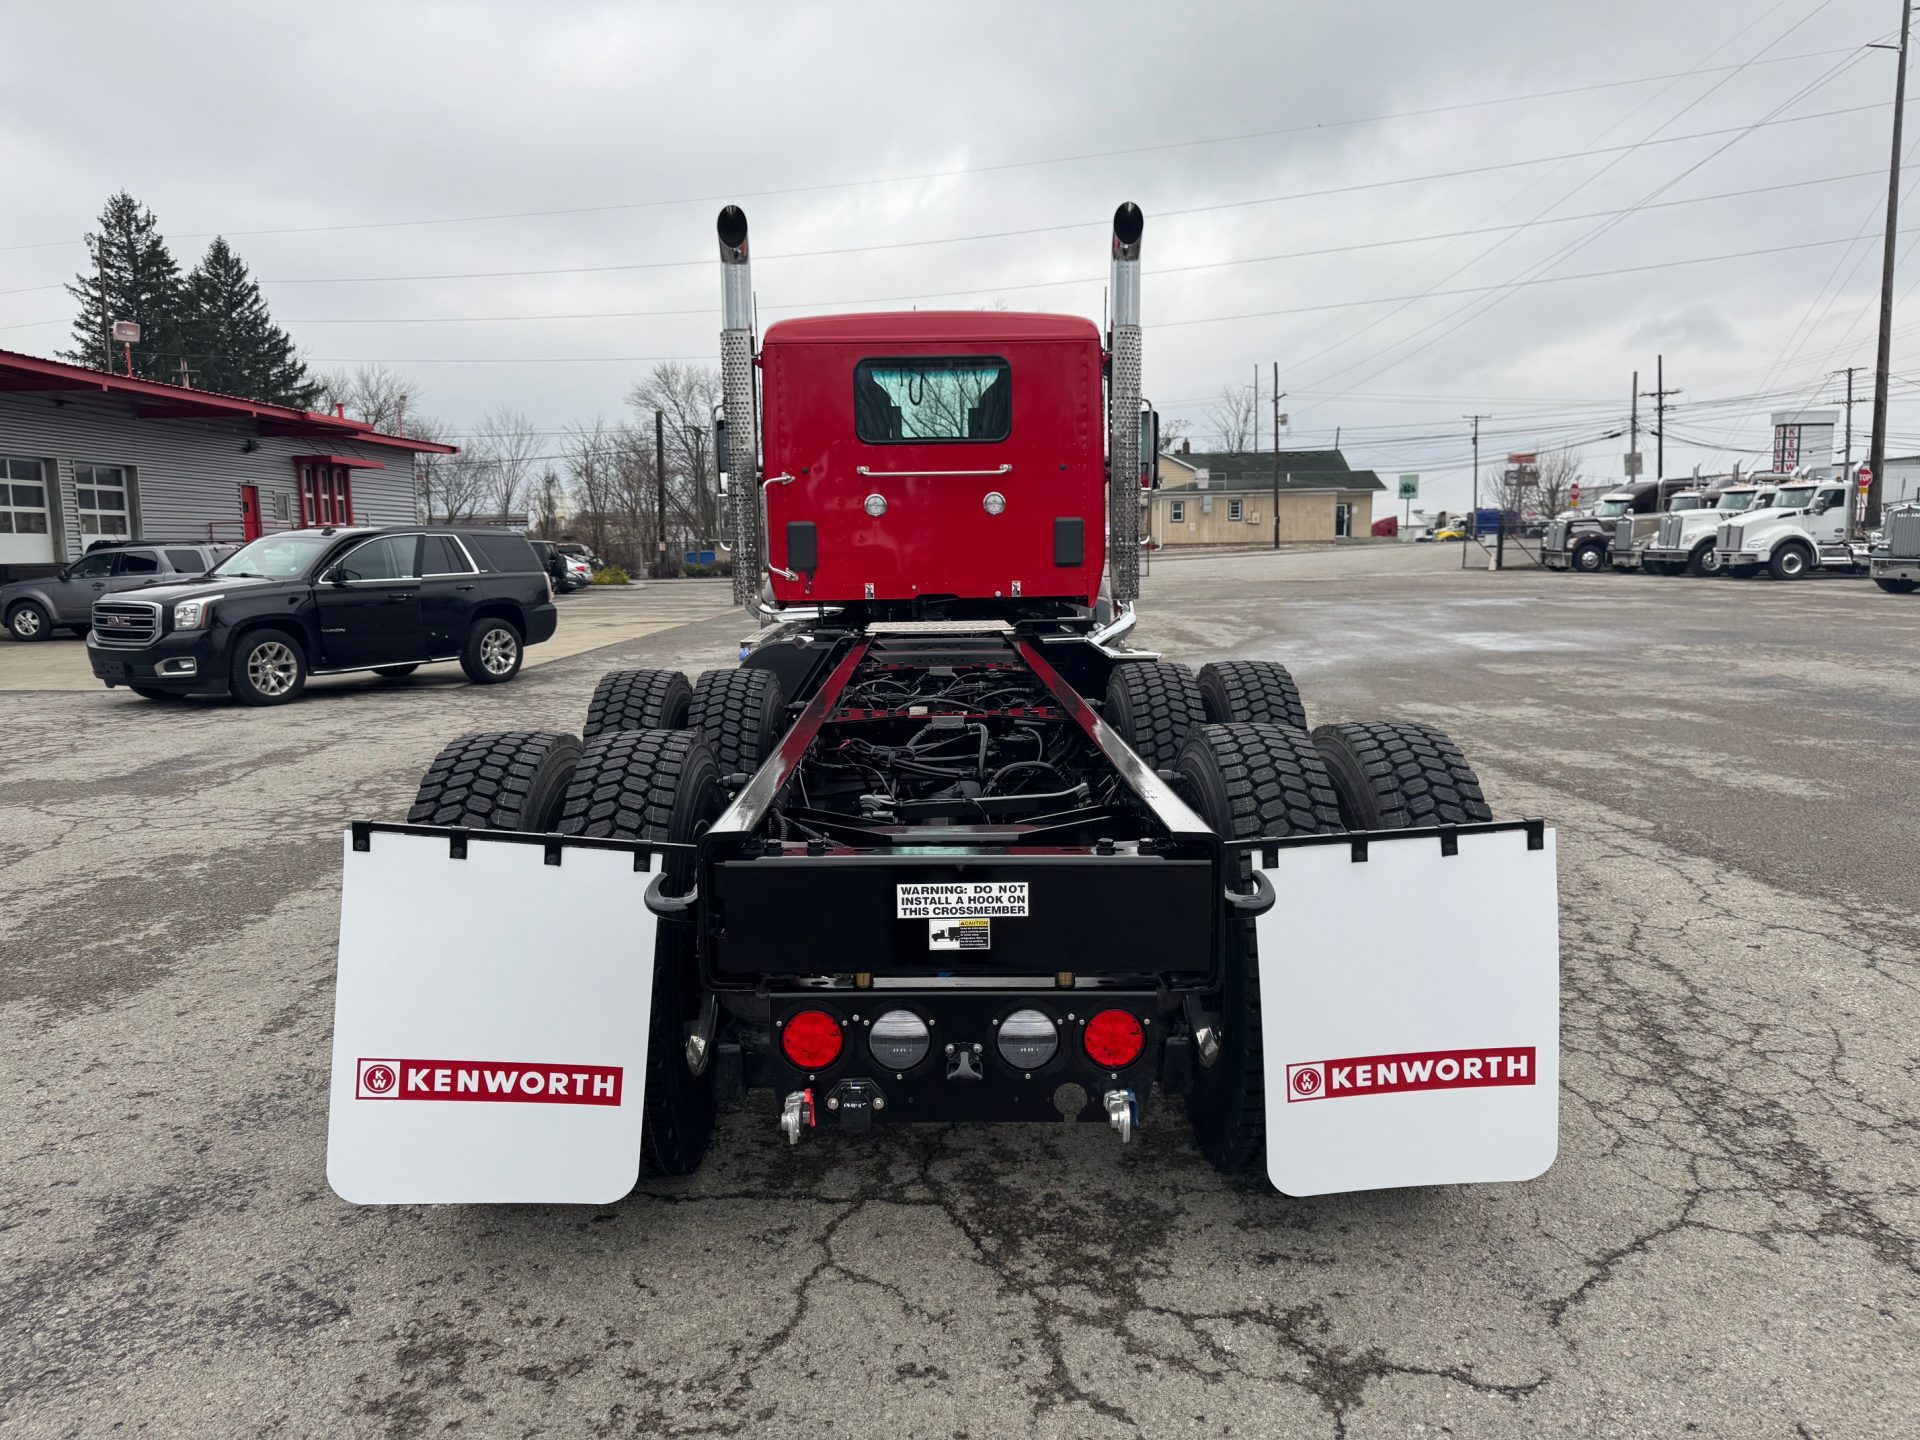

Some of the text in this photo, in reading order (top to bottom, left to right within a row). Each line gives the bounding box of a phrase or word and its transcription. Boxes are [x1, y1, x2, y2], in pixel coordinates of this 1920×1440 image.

[900, 885, 1026, 895] WARNING: DO NOT
[901, 895, 1026, 906] INSTALL A HOOK ON
[901, 906, 1026, 916] THIS CROSSMEMBER
[1332, 1055, 1528, 1090] KENWORTH
[407, 1068, 615, 1097] KENWORTH
